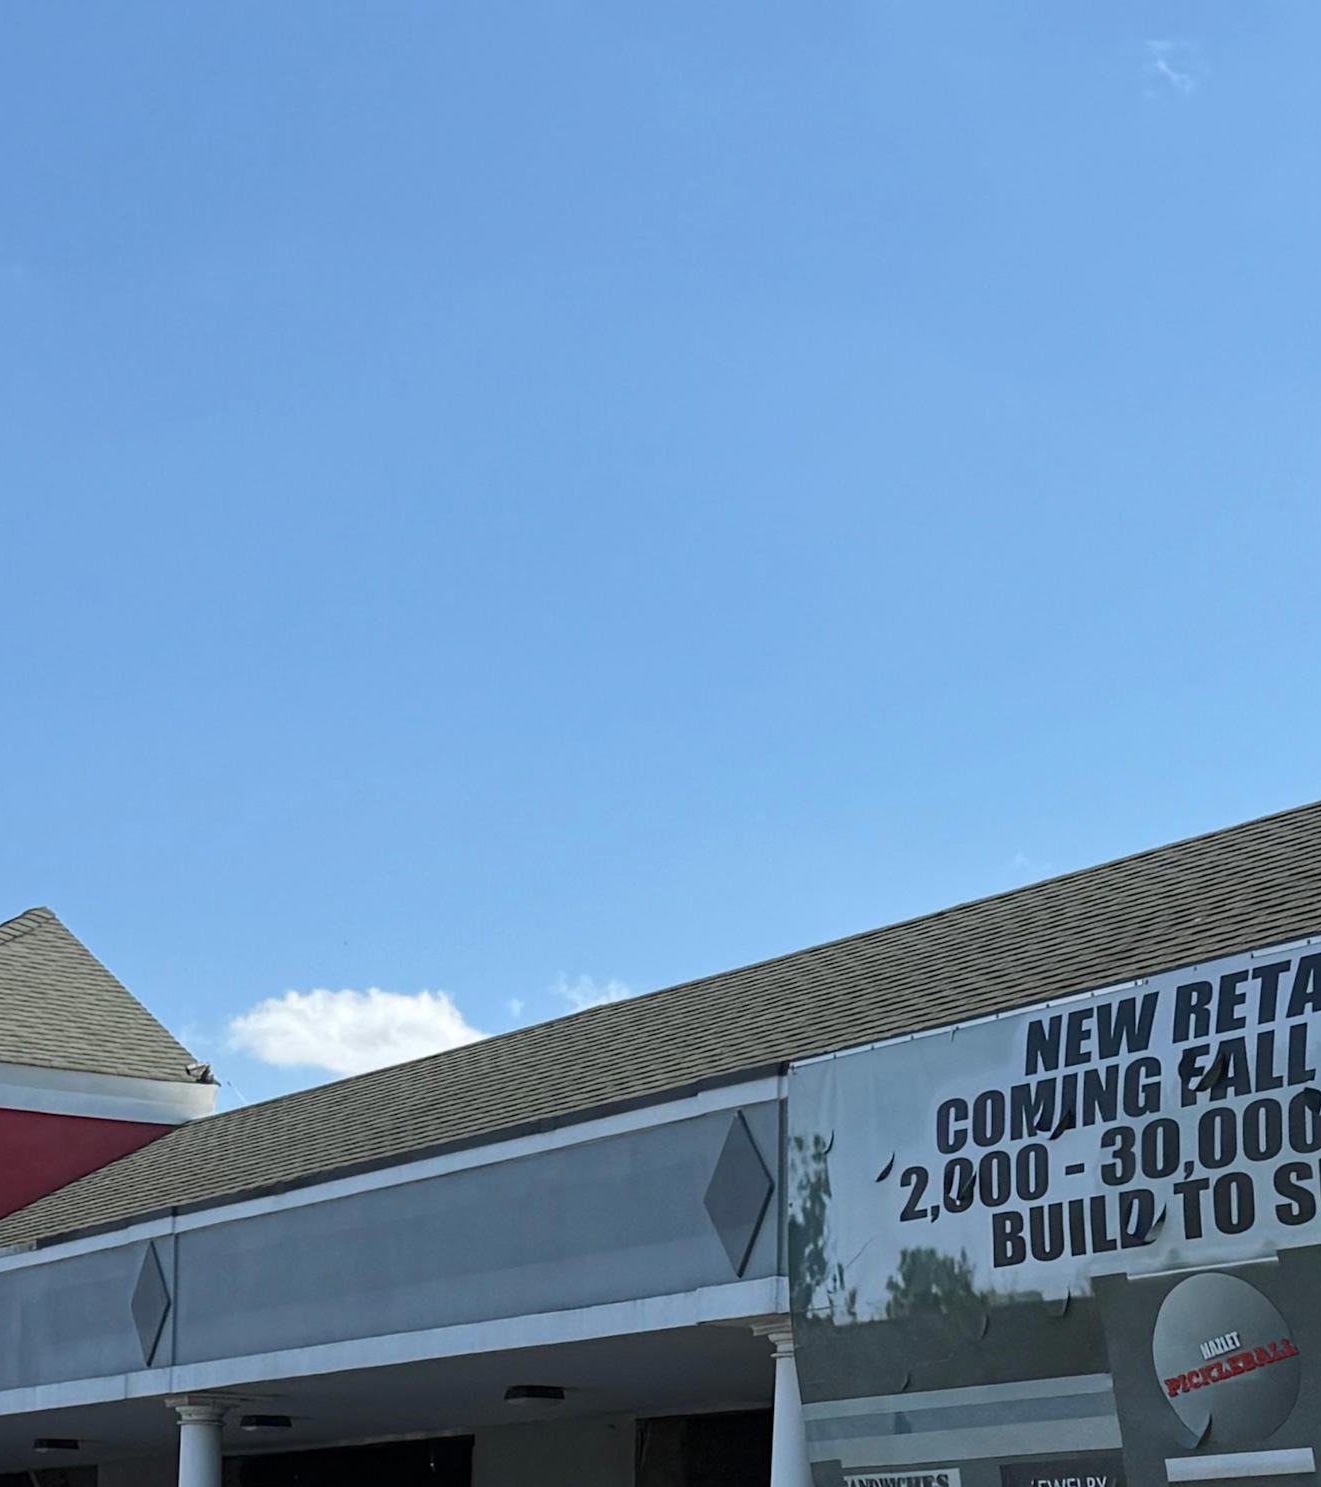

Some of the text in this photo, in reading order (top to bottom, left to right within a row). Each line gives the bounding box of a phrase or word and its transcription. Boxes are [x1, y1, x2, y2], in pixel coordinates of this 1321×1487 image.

[1025, 991, 1159, 1075] NEW
[937, 1056, 1162, 1154] COMING
[1178, 1022, 1316, 1108] FALL
[900, 1143, 1049, 1223] 2,000
[1065, 1162, 1085, 1176] -
[992, 1188, 1157, 1268] BUILD
[1173, 1171, 1255, 1240] TO
